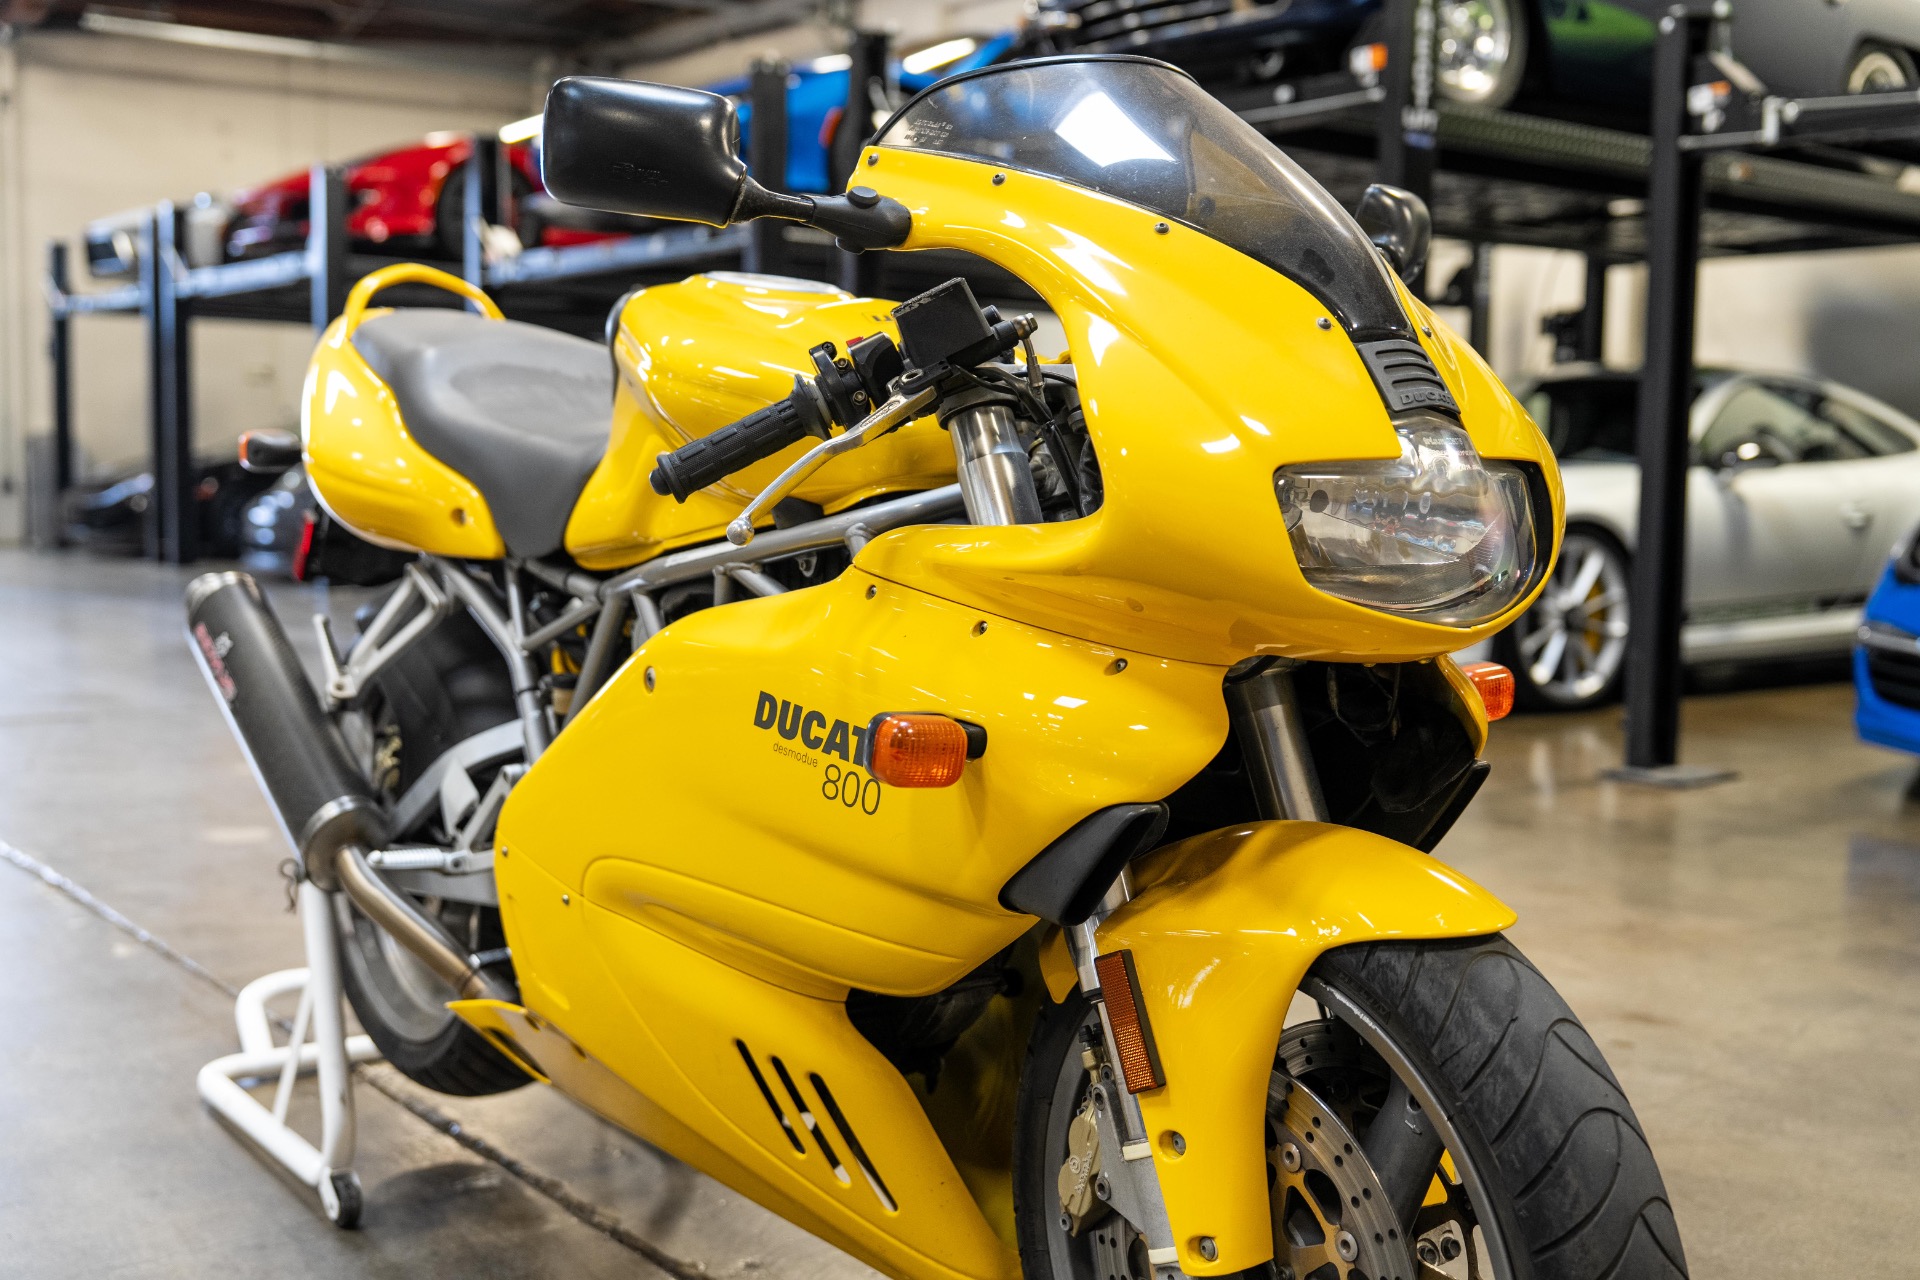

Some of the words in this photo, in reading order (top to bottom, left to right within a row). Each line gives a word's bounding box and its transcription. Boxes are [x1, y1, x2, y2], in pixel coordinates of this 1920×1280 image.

[753, 690, 867, 768] DUCAT
[773, 741, 818, 768] desmodue
[822, 764, 881, 815] 800
